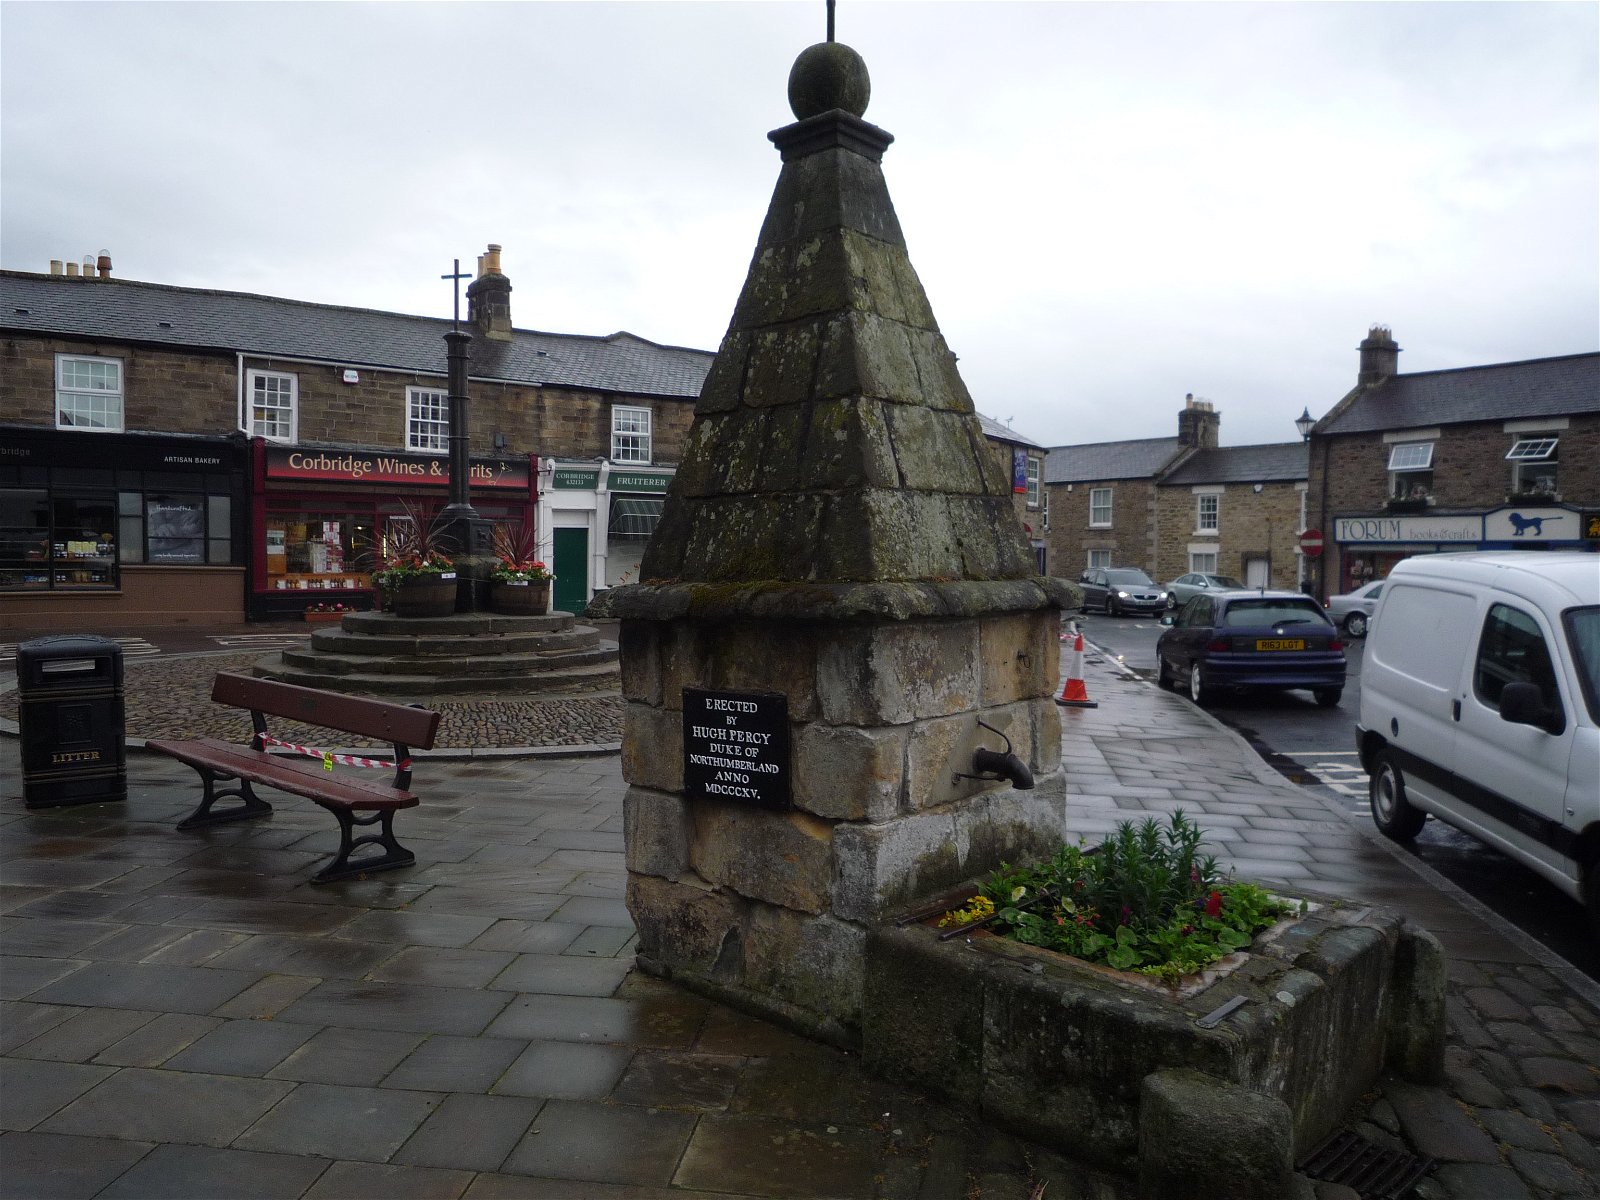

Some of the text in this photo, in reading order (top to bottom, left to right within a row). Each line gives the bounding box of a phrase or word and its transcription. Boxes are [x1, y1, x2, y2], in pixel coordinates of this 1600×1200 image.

[164, 456, 220, 465] ARTISAN BAKERY
[289, 453, 372, 477] Corbridge
[377, 458, 425, 475] Wines
[430, 461, 442, 476] &
[617, 477, 666, 486] FRUITERER
[1341, 520, 1400, 540] FORUM
[706, 698, 758, 713] ERECTED
[726, 716, 738, 725] BY
[692, 726, 771, 745] HUGH PERCY
[51, 751, 101, 763] LITTER
[709, 743, 759, 758] DUKE OF
[690, 754, 780, 774] NORTHUMBERLAND
[715, 771, 750, 784] ANNO
[705, 783, 760, 800] MDCCCXV.
